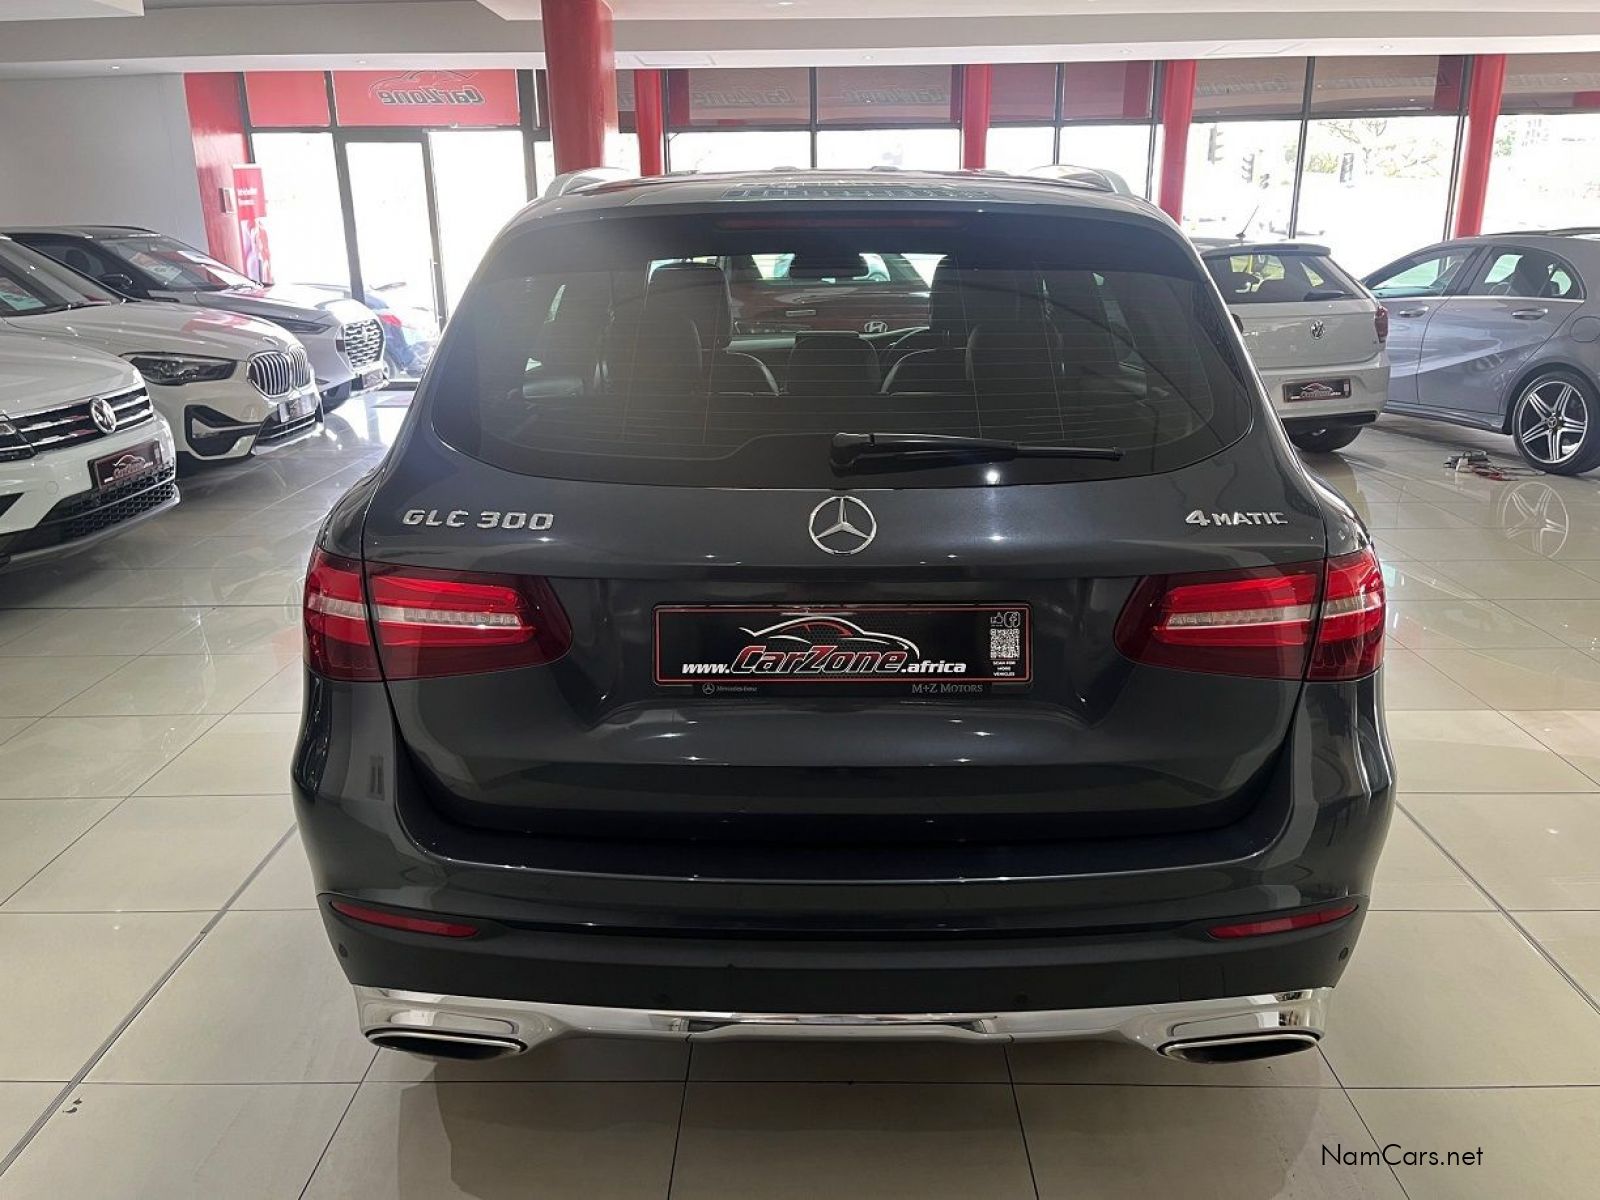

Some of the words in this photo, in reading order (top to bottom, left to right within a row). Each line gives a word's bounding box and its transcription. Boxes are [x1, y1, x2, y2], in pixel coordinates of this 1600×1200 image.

[402, 509, 469, 528] GLC
[476, 510, 554, 531] 300
[681, 644, 967, 675] www.CarZone.africa
[911, 683, 938, 694] M+Z
